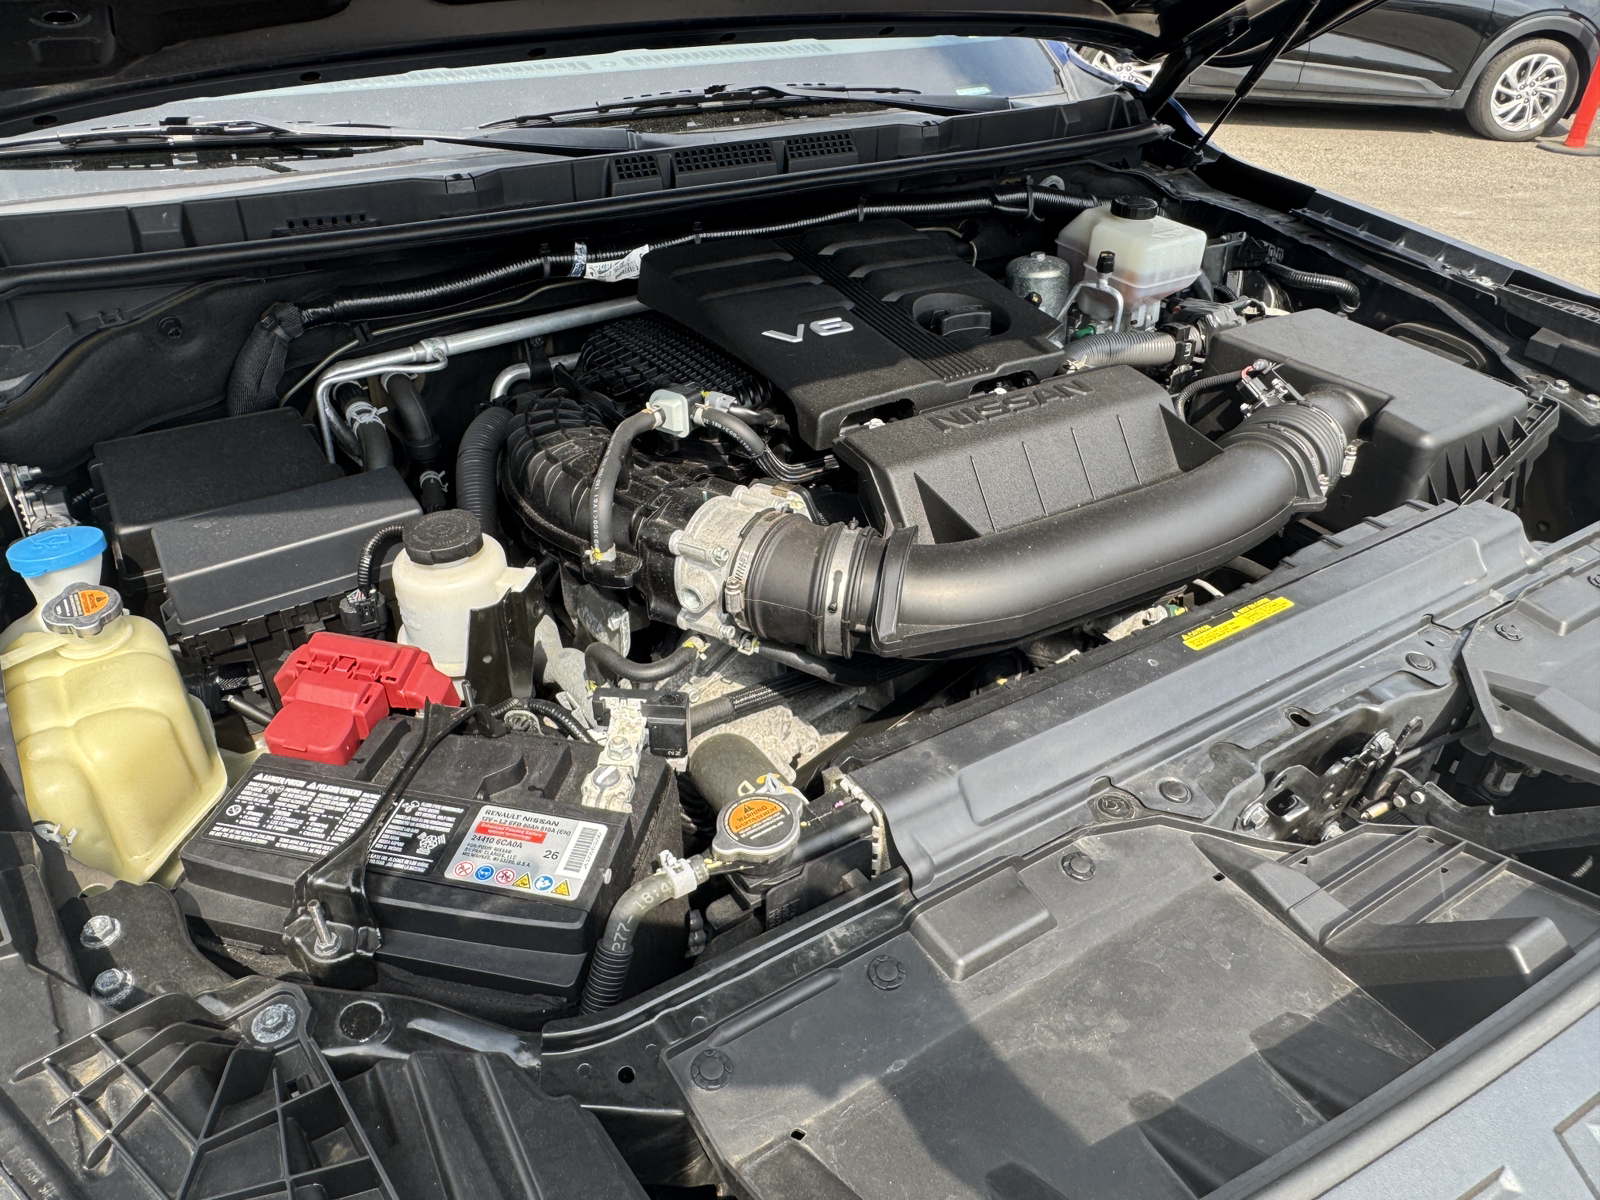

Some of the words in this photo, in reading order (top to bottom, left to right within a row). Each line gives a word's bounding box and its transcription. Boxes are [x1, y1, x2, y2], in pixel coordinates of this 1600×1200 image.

[761, 317, 854, 343] V6
[926, 379, 1094, 433] NISSAN
[484, 809, 521, 820] RENAULT
[522, 816, 560, 827] NISSAN
[737, 805, 768, 822] WARNING
[481, 823, 505, 832] Enhanced
[524, 829, 543, 838] Battery
[471, 835, 495, 844] 24410
[495, 839, 523, 849] 6CA0A
[543, 850, 560, 860] 26
[633, 881, 674, 910] 18:4
